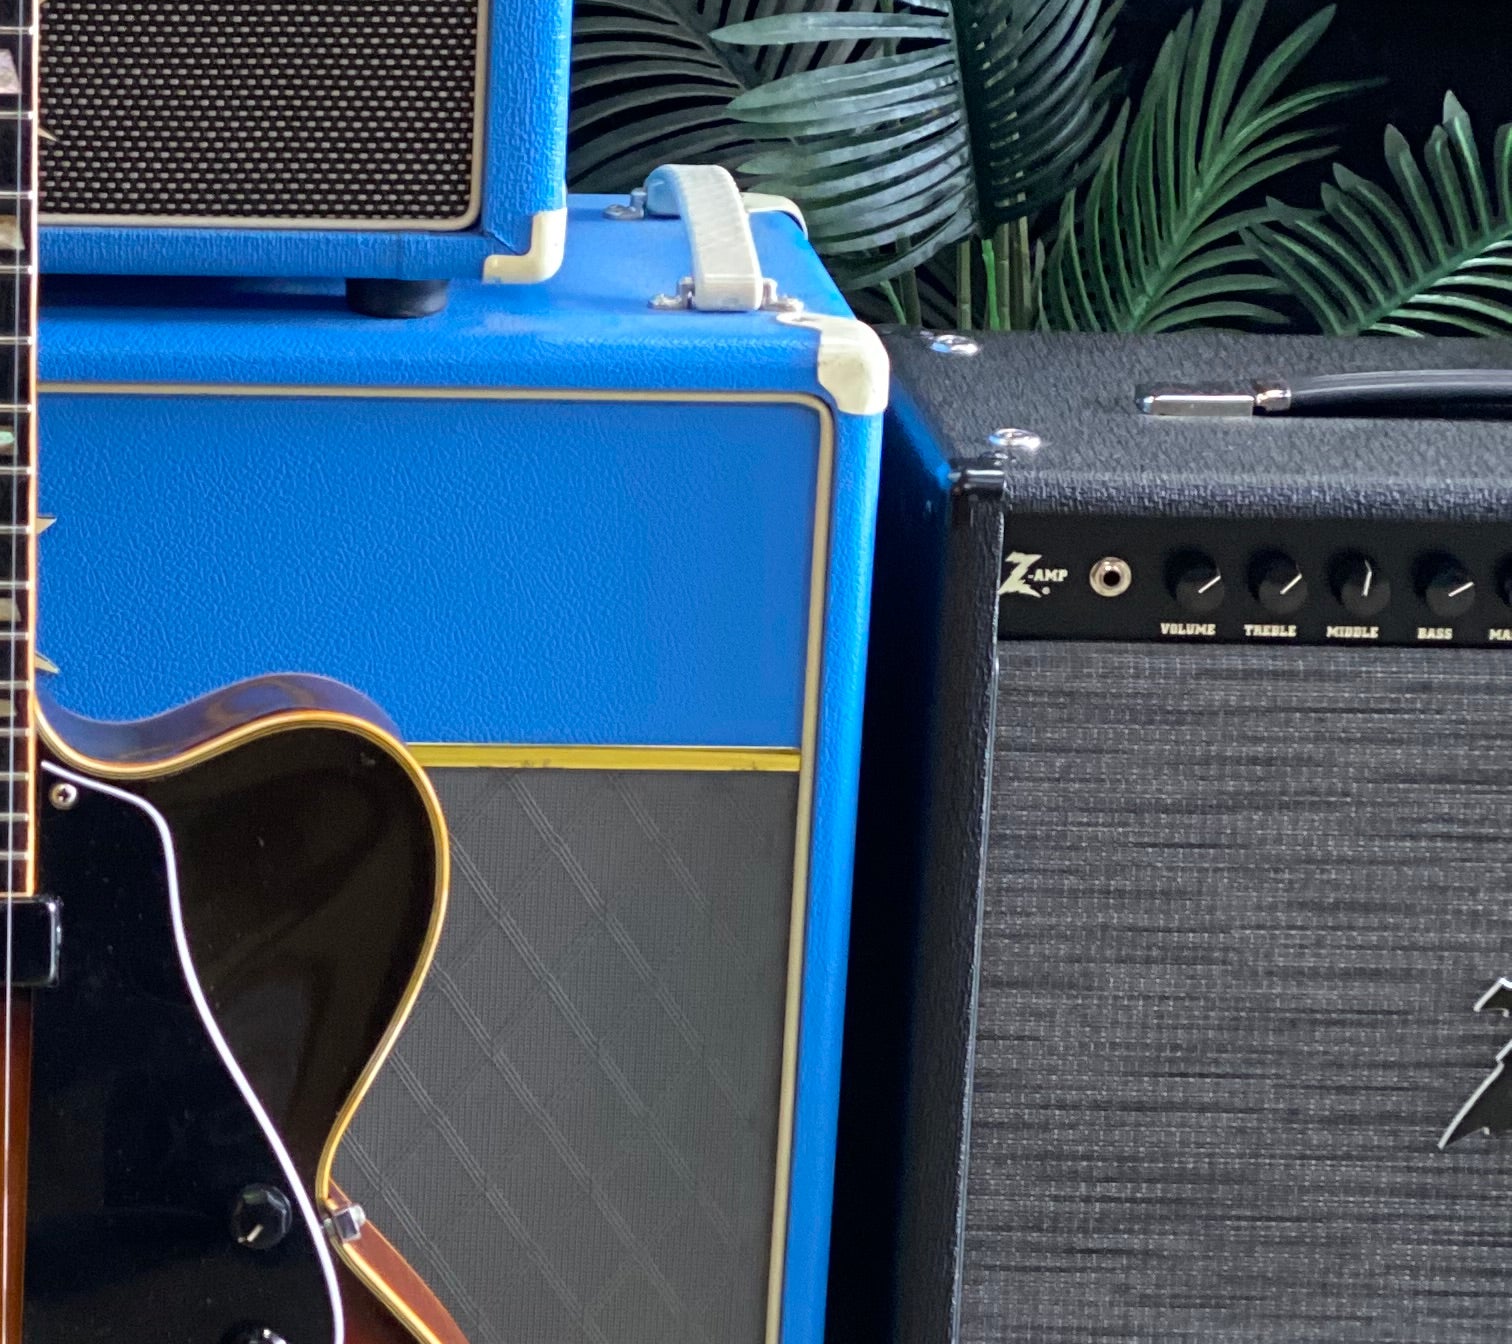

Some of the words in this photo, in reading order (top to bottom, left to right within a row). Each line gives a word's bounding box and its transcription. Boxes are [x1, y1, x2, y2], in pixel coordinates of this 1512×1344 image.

[1160, 622, 1217, 636] VOLUME
[1244, 624, 1297, 637] TREBLE
[1326, 626, 1380, 638] MIDDLE
[1417, 627, 1453, 640] BASS
